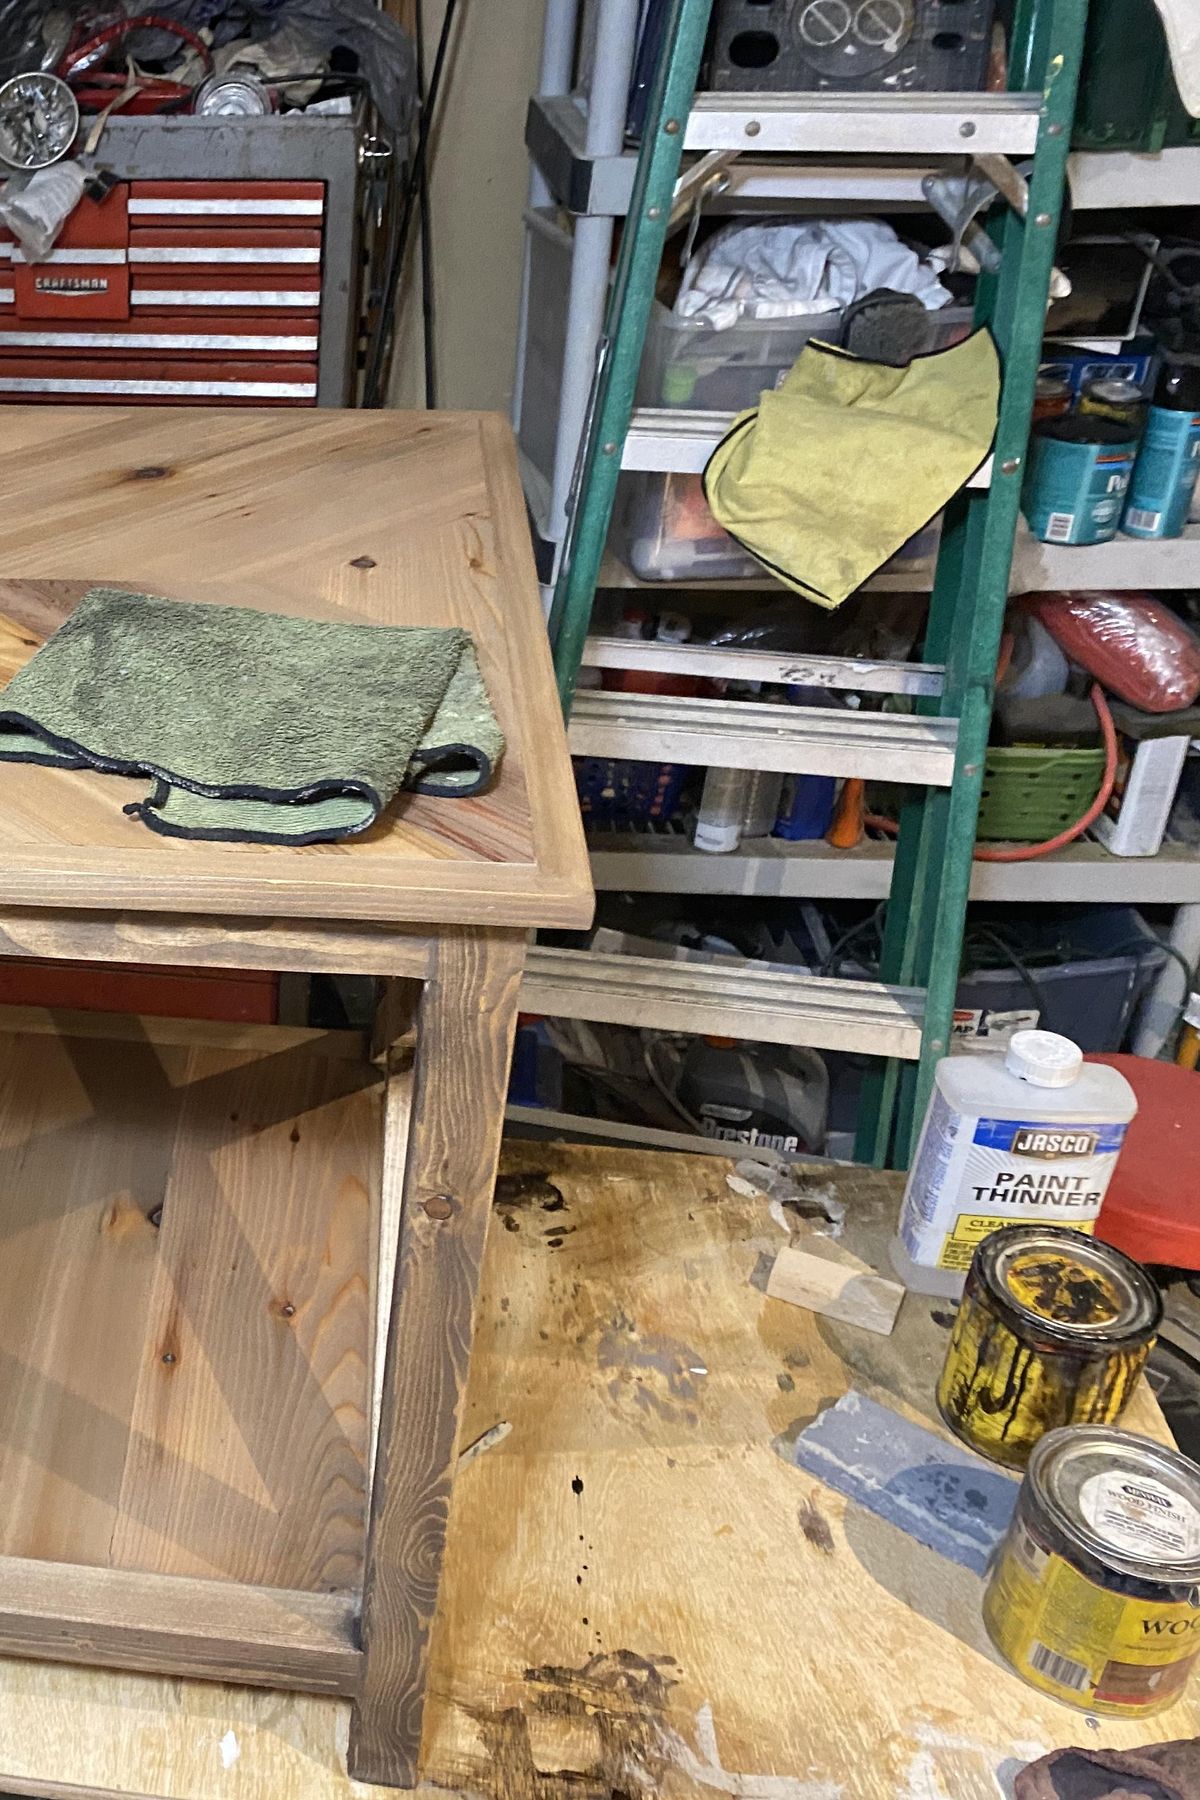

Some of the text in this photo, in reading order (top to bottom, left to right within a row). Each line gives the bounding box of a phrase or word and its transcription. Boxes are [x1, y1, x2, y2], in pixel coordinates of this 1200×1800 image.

[35, 278, 108, 289] CRAFTSMAN
[703, 1117, 799, 1153] Prestone
[1017, 1134, 1090, 1153] JASCO
[995, 1172, 1090, 1191] PAINT
[972, 1186, 1102, 1207] THINNER
[1107, 1489, 1186, 1523] WOOD FINISH
